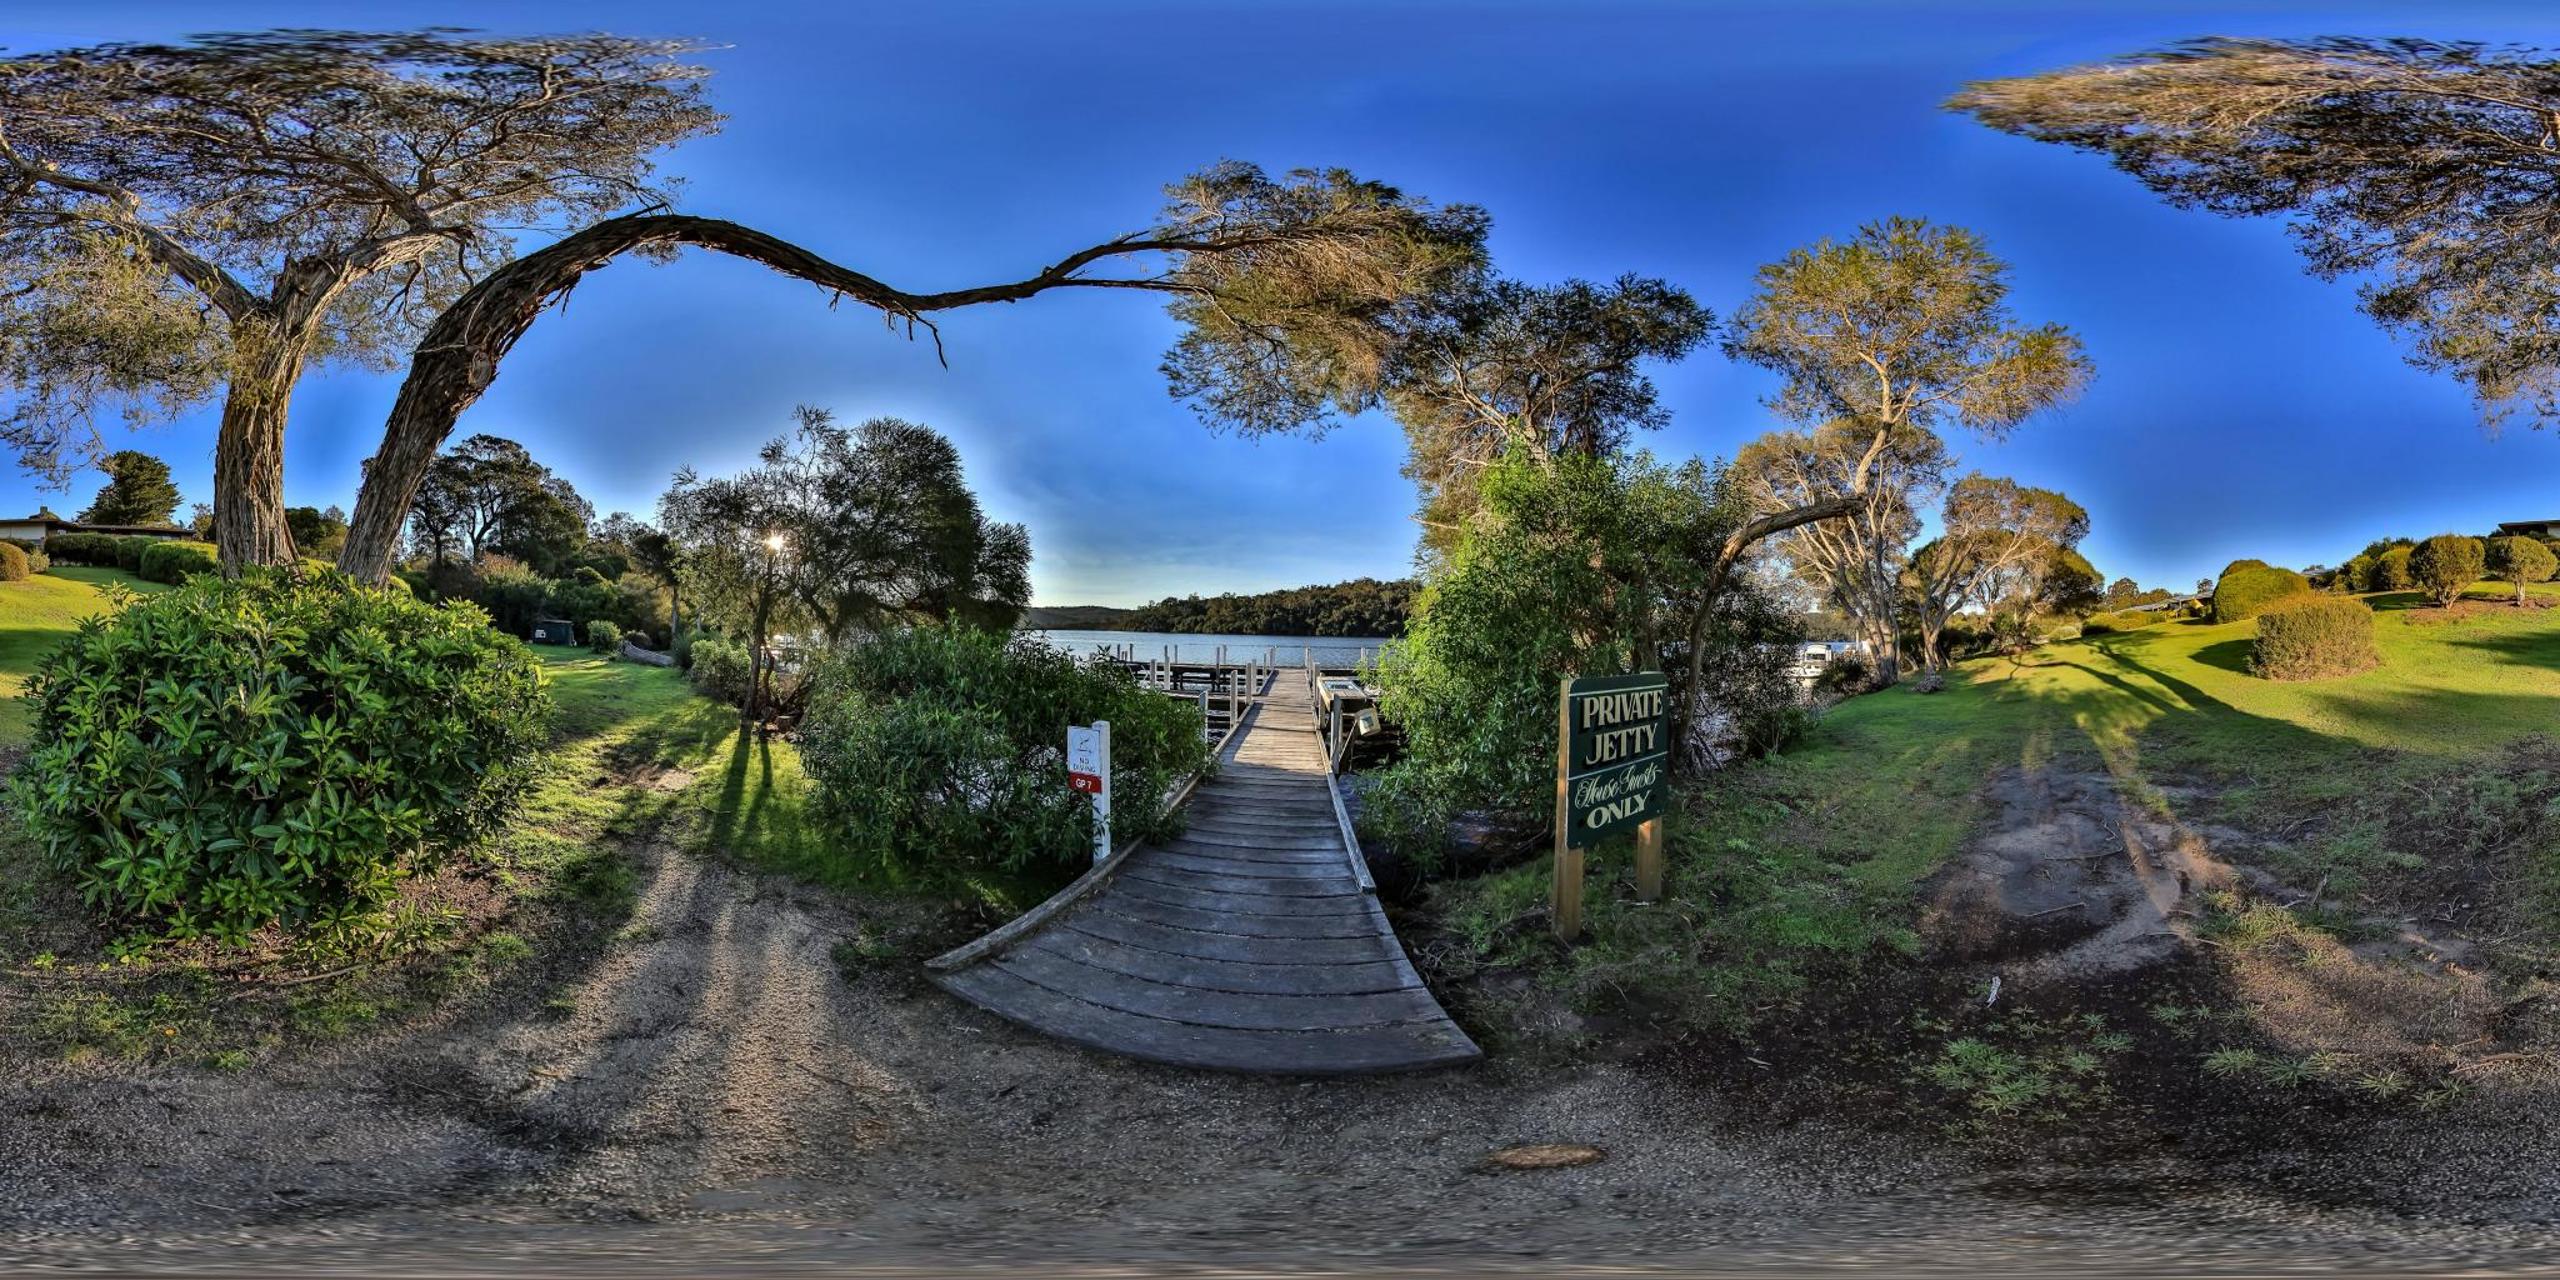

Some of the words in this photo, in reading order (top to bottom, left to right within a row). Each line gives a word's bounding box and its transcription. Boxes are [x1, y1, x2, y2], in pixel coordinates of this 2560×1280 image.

[1583, 690, 1663, 729] PRIVATE
[1586, 723, 1657, 766] JETTY
[1575, 776, 1620, 809] House
[1619, 763, 1662, 793] Guests
[1587, 789, 1652, 829] ONLY
